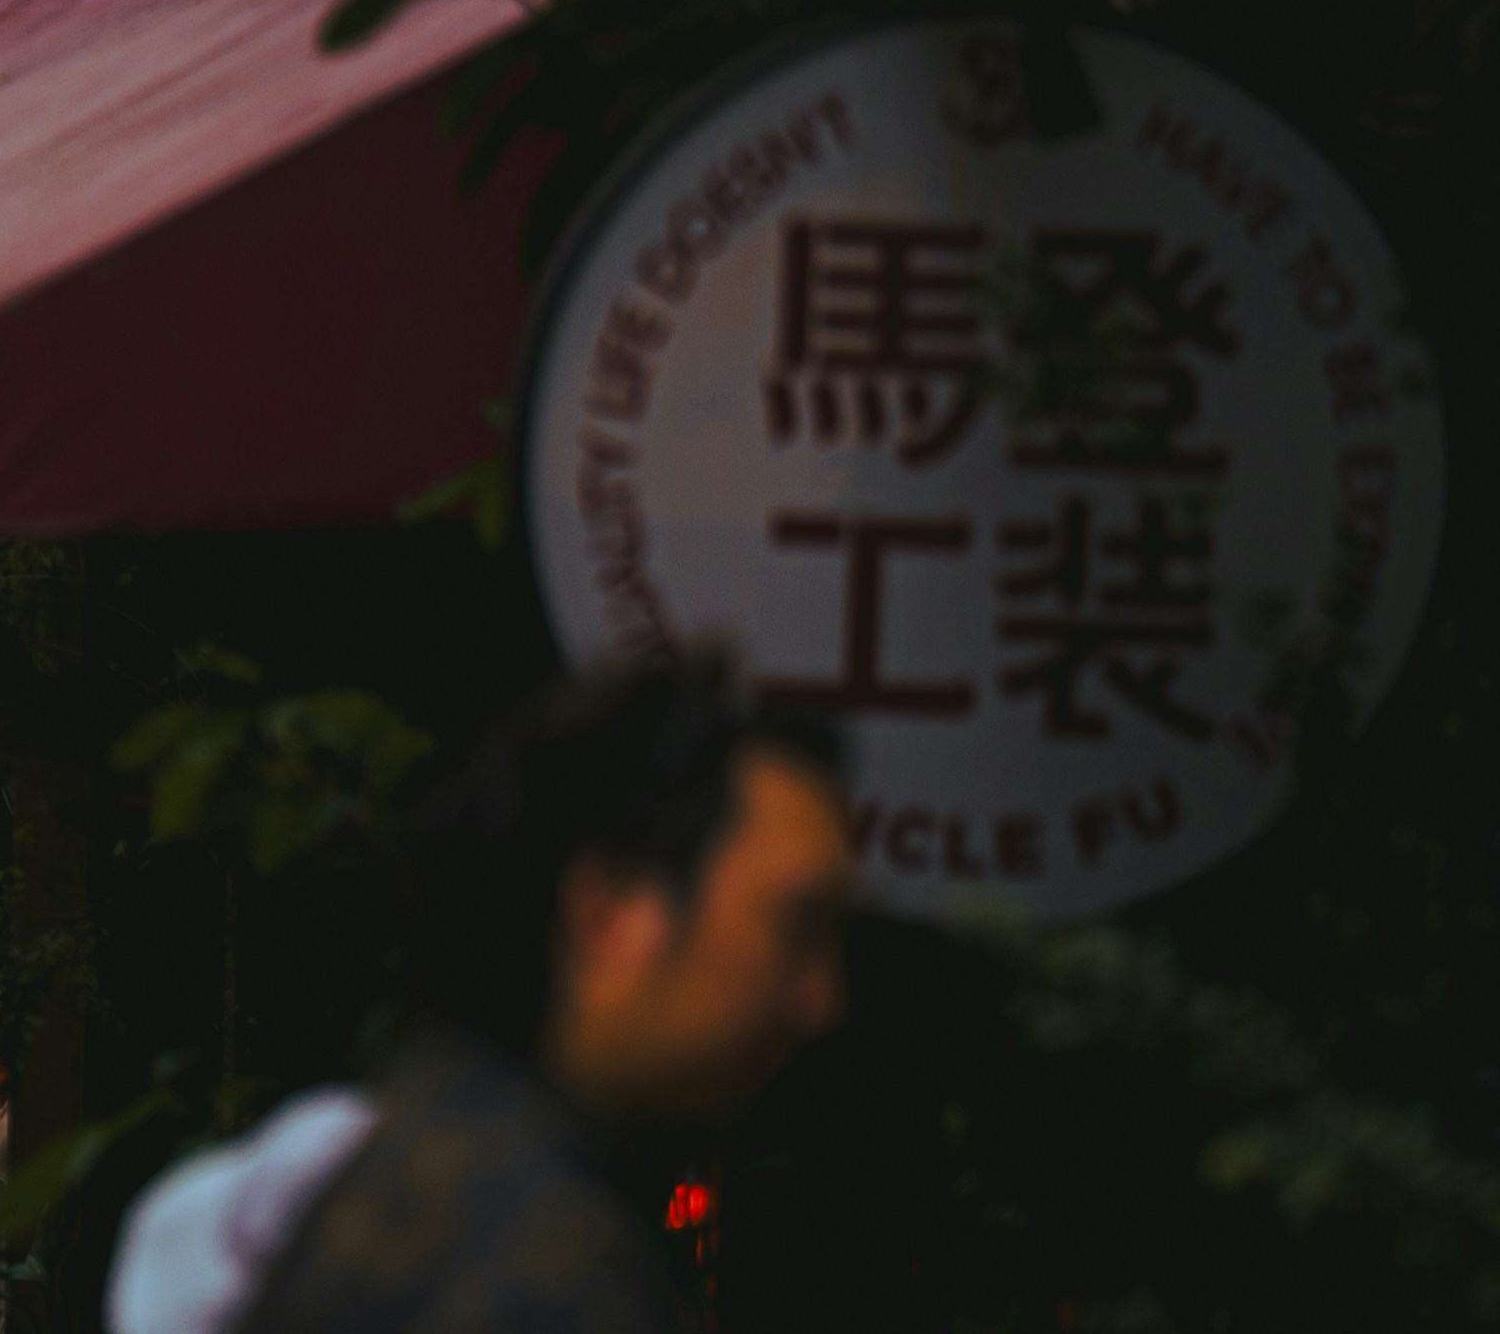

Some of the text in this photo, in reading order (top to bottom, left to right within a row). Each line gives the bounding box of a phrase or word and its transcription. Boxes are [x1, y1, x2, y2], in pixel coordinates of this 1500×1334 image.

[1278, 239, 1360, 334] TO
[845, 772, 1186, 879] NCLE FU
